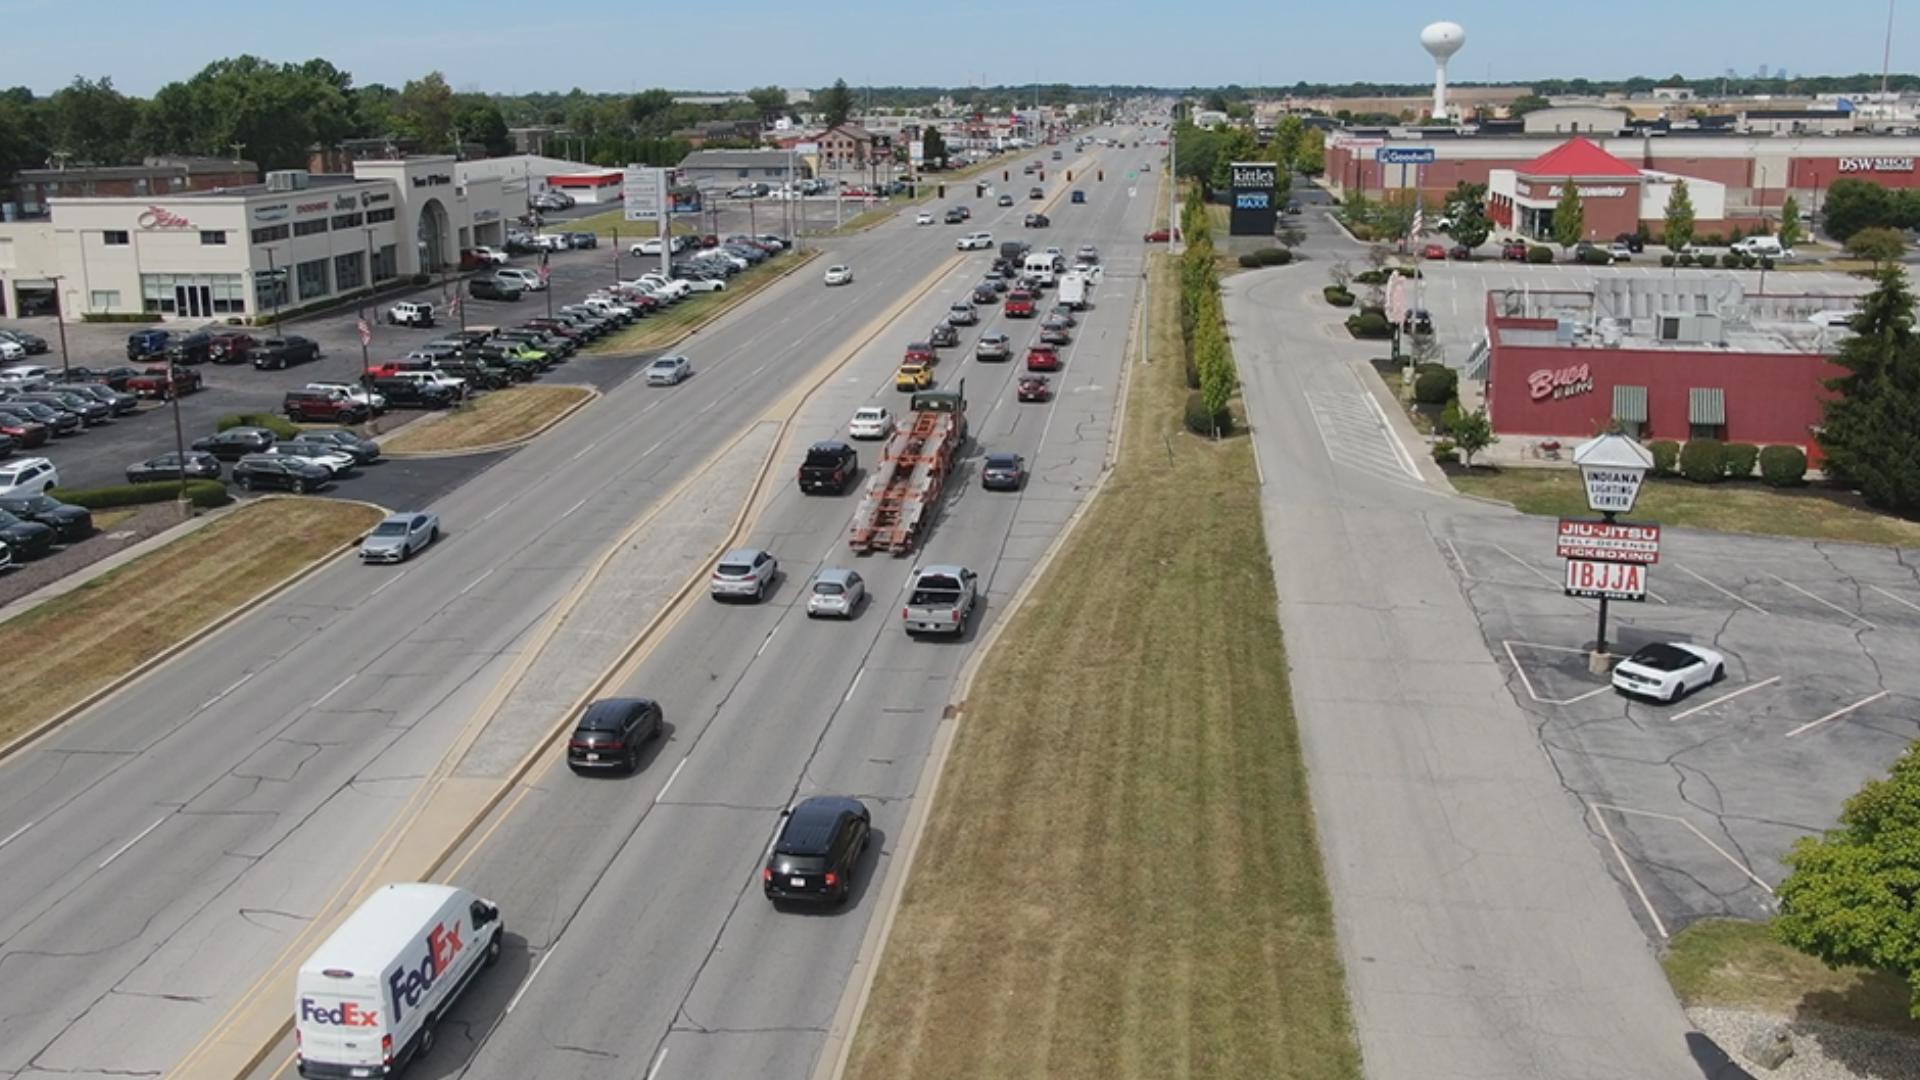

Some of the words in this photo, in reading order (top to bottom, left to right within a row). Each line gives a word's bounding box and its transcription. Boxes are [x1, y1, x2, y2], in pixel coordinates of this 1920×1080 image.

[1390, 152, 1433, 161] Goodwill
[1839, 158, 1874, 170] DSW
[1233, 168, 1274, 181] kittle's
[1236, 199, 1269, 208] MAXX
[1587, 471, 1638, 483] INDIANA
[1591, 483, 1633, 495] LIGHTING
[1593, 495, 1629, 505] CENTER
[1561, 523, 1657, 540] JIU-JITSU
[1560, 547, 1655, 561] KICKBOXING
[1570, 560, 1640, 591] IBJJA
[389, 920, 464, 1024] FedEx
[302, 998, 379, 1027] FedEx
